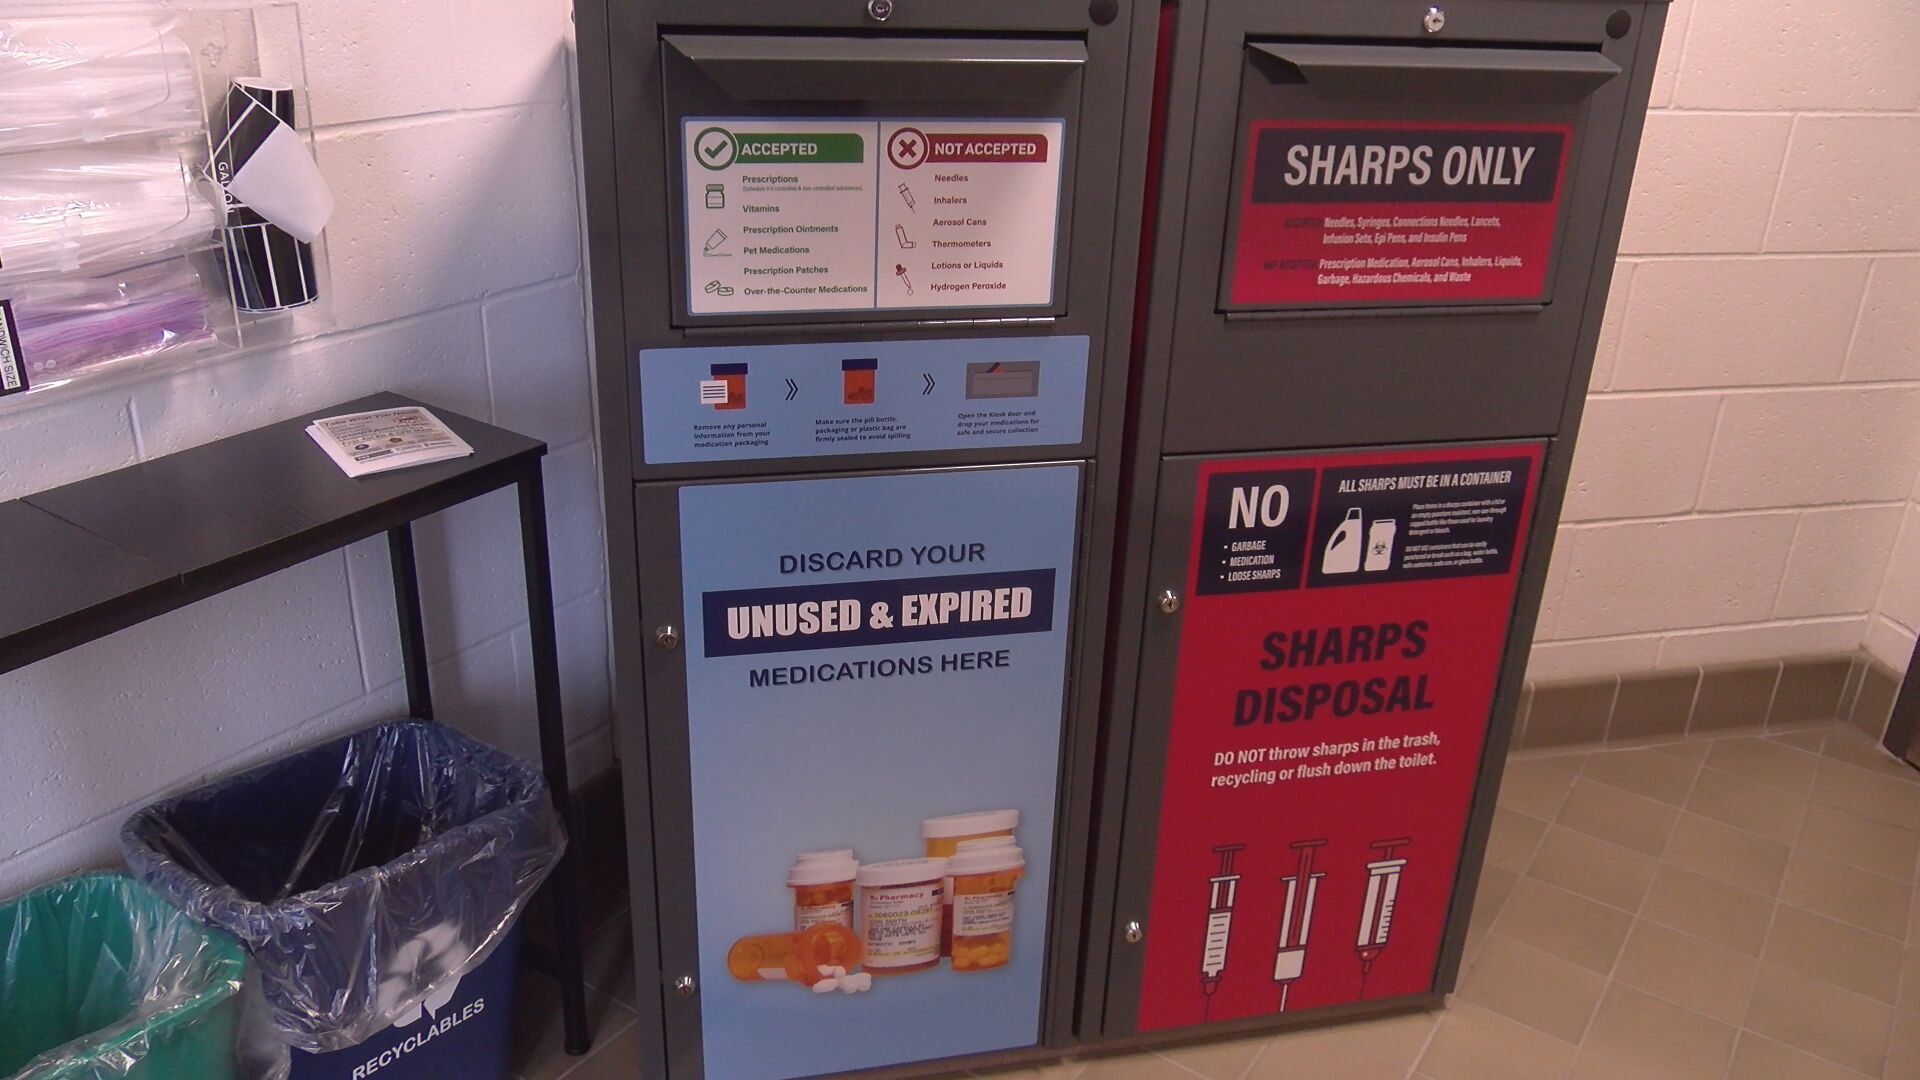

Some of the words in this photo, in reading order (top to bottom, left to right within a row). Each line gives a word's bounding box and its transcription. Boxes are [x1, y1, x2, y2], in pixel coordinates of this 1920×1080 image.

[741, 143, 818, 156] ACCEPTED
[934, 143, 963, 155] NOT
[965, 143, 1037, 155] ACCEPTED
[1284, 144, 1433, 187] SHARPS
[1442, 146, 1535, 186] ONLY
[742, 175, 799, 185] Prescriptions
[934, 174, 969, 182] Needles
[934, 196, 967, 204] Inhalers
[742, 205, 780, 213] Vitamins
[933, 218, 965, 226] Aerosol
[966, 218, 987, 226] Cans
[1324, 217, 1356, 228] Needles,
[1357, 216, 1392, 230] Syringes,
[1393, 216, 1438, 228] Connections
[1439, 216, 1470, 228] Needles,
[743, 226, 794, 235] Prescription
[795, 225, 839, 233] Ointments
[932, 240, 992, 248] Thermometers
[1323, 233, 1354, 244] Infusion
[1374, 233, 1387, 245] Epi
[1407, 232, 1424, 243] and
[1423, 232, 1449, 243] Insulin
[1449, 231, 1467, 242] Pens
[759, 246, 810, 254] Medications
[931, 261, 962, 270] Lotions
[974, 261, 1003, 270] Liquids
[1319, 258, 1366, 271] Prescription
[1366, 257, 1410, 269] Medication,
[1411, 257, 1440, 267] Aerosol
[1461, 256, 1493, 268] Inhalers,
[744, 267, 794, 276] Prescription
[795, 266, 829, 274] Patches
[1317, 273, 1351, 287] Garbage,
[1352, 272, 1392, 284] Hazardous
[1393, 271, 1432, 283] Chemicals,
[1433, 271, 1449, 282] and
[1448, 271, 1471, 282] Waste
[744, 287, 816, 296] Over-the-Counter
[818, 285, 868, 294] Medications
[930, 282, 970, 292] Hydrogen
[971, 281, 1007, 290] Peroxide
[4, 364, 17, 388] SIZE
[864, 416, 875, 424] pill
[958, 413, 975, 421] Open
[1023, 409, 1036, 417] and
[737, 421, 767, 430] personal
[957, 420, 973, 429] drop
[974, 420, 989, 428] your
[990, 418, 1029, 426] medications
[1030, 417, 1040, 425] for
[693, 431, 735, 440] information
[736, 430, 753, 438] from
[754, 430, 771, 438] your
[815, 426, 849, 435] packaging
[859, 424, 880, 433] plastic
[882, 424, 895, 432] bag
[957, 429, 971, 437] safe
[971, 428, 985, 436] and
[986, 428, 1006, 436] secure
[1007, 426, 1039, 434] collection
[694, 440, 733, 448] medication
[734, 439, 769, 447] packaging
[815, 435, 836, 443] firmly
[836, 434, 858, 442] sealed
[868, 432, 886, 440] avoid
[887, 432, 911, 440] spilling
[1338, 479, 1357, 493] ALL
[1358, 476, 1397, 492] SHARPS
[1397, 475, 1426, 490] MUST
[1426, 474, 1440, 488] BE
[1439, 474, 1450, 487] IN
[1451, 473, 1459, 487] A
[1460, 470, 1512, 486] CONTAINER
[1228, 484, 1289, 530] NO
[1231, 540, 1267, 552] GARBAGE
[779, 548, 903, 574] DISCARD
[910, 543, 986, 567] YOUR
[1229, 554, 1275, 567] MEDICATION
[1227, 570, 1252, 582] LOOSE
[1251, 568, 1281, 580] SHARPS
[727, 598, 861, 640] UNUSED
[869, 601, 894, 630] &
[902, 586, 1033, 627] EXPIRED
[1259, 619, 1428, 671] SHARPS
[750, 655, 933, 687] MEDICATIONS
[941, 649, 1010, 673] HERE
[1233, 673, 1435, 727] DISPOSAL
[1214, 751, 1235, 767] DO
[1238, 748, 1267, 765] NOT
[1268, 744, 1310, 761] throw
[1312, 740, 1359, 757] sharps
[1362, 738, 1375, 752] in
[1378, 735, 1401, 750] the
[1403, 731, 1441, 747] trash,
[1210, 767, 1276, 789] recycling
[1279, 768, 1294, 782] or
[1296, 764, 1331, 779] flush
[1334, 758, 1372, 775] down
[1374, 755, 1397, 771] the
[1399, 752, 1437, 768] toilet.
[879, 893, 924, 901] Pharmacy
[352, 998, 485, 1080] RECYCLABLES
